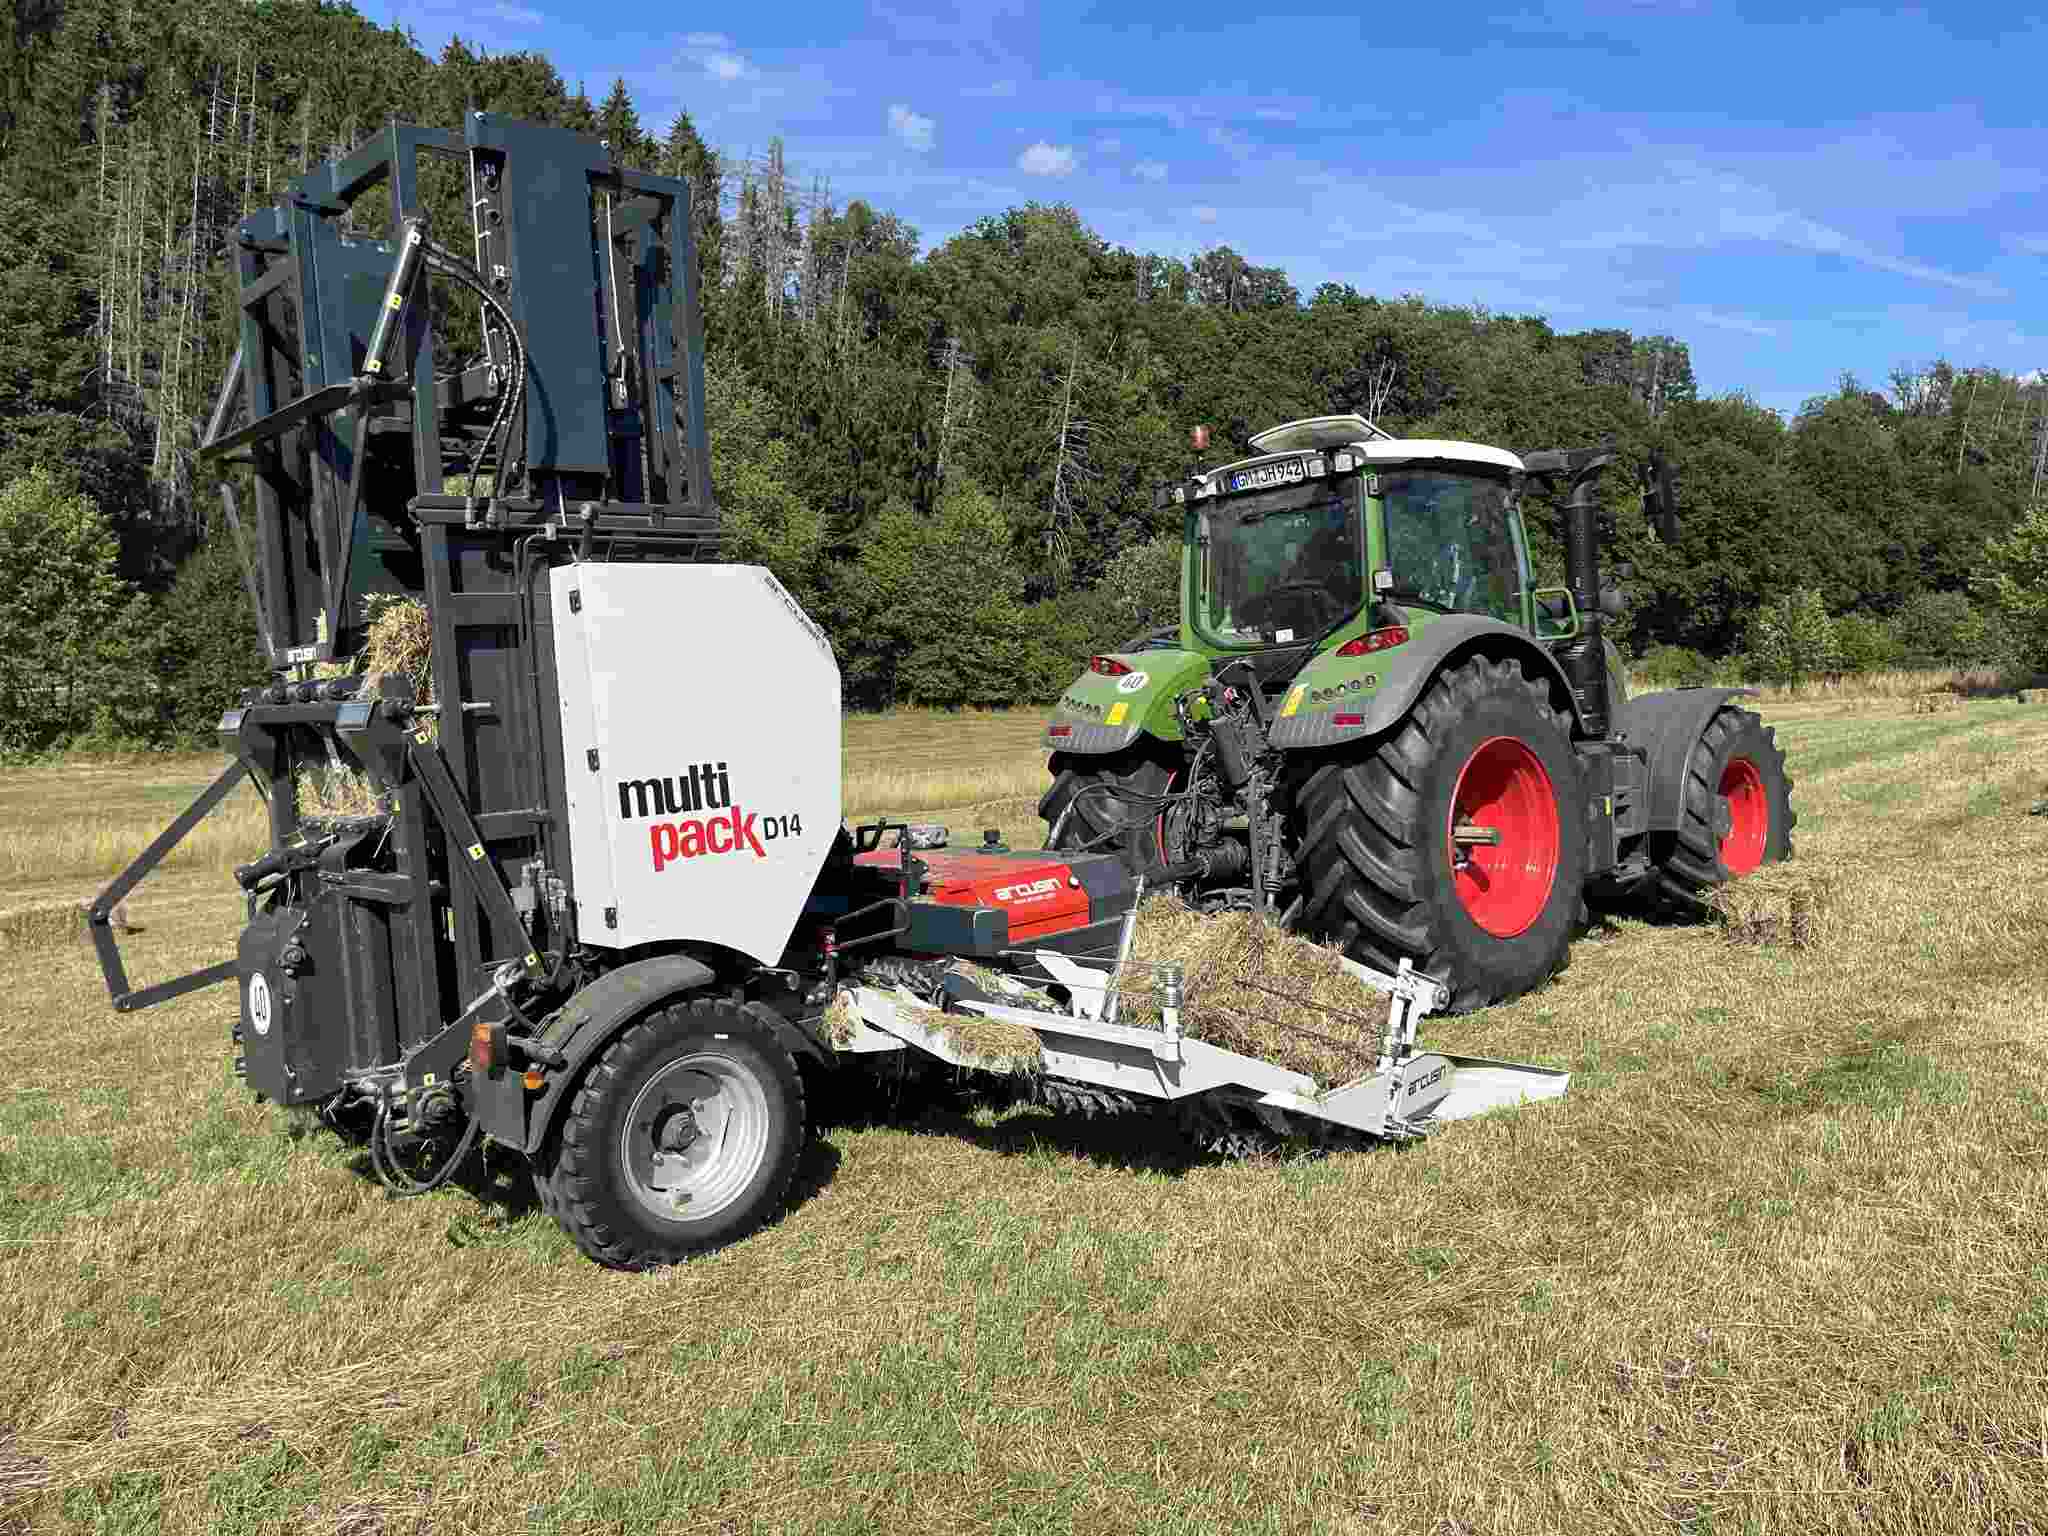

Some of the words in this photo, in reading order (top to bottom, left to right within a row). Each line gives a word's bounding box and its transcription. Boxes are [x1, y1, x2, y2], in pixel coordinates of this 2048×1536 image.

[493, 264, 505, 277] 12
[1278, 460, 1302, 481] 942
[617, 762, 730, 819] multi
[650, 806, 766, 872] pack
[763, 814, 801, 841] D14
[254, 985, 267, 1022] 40
